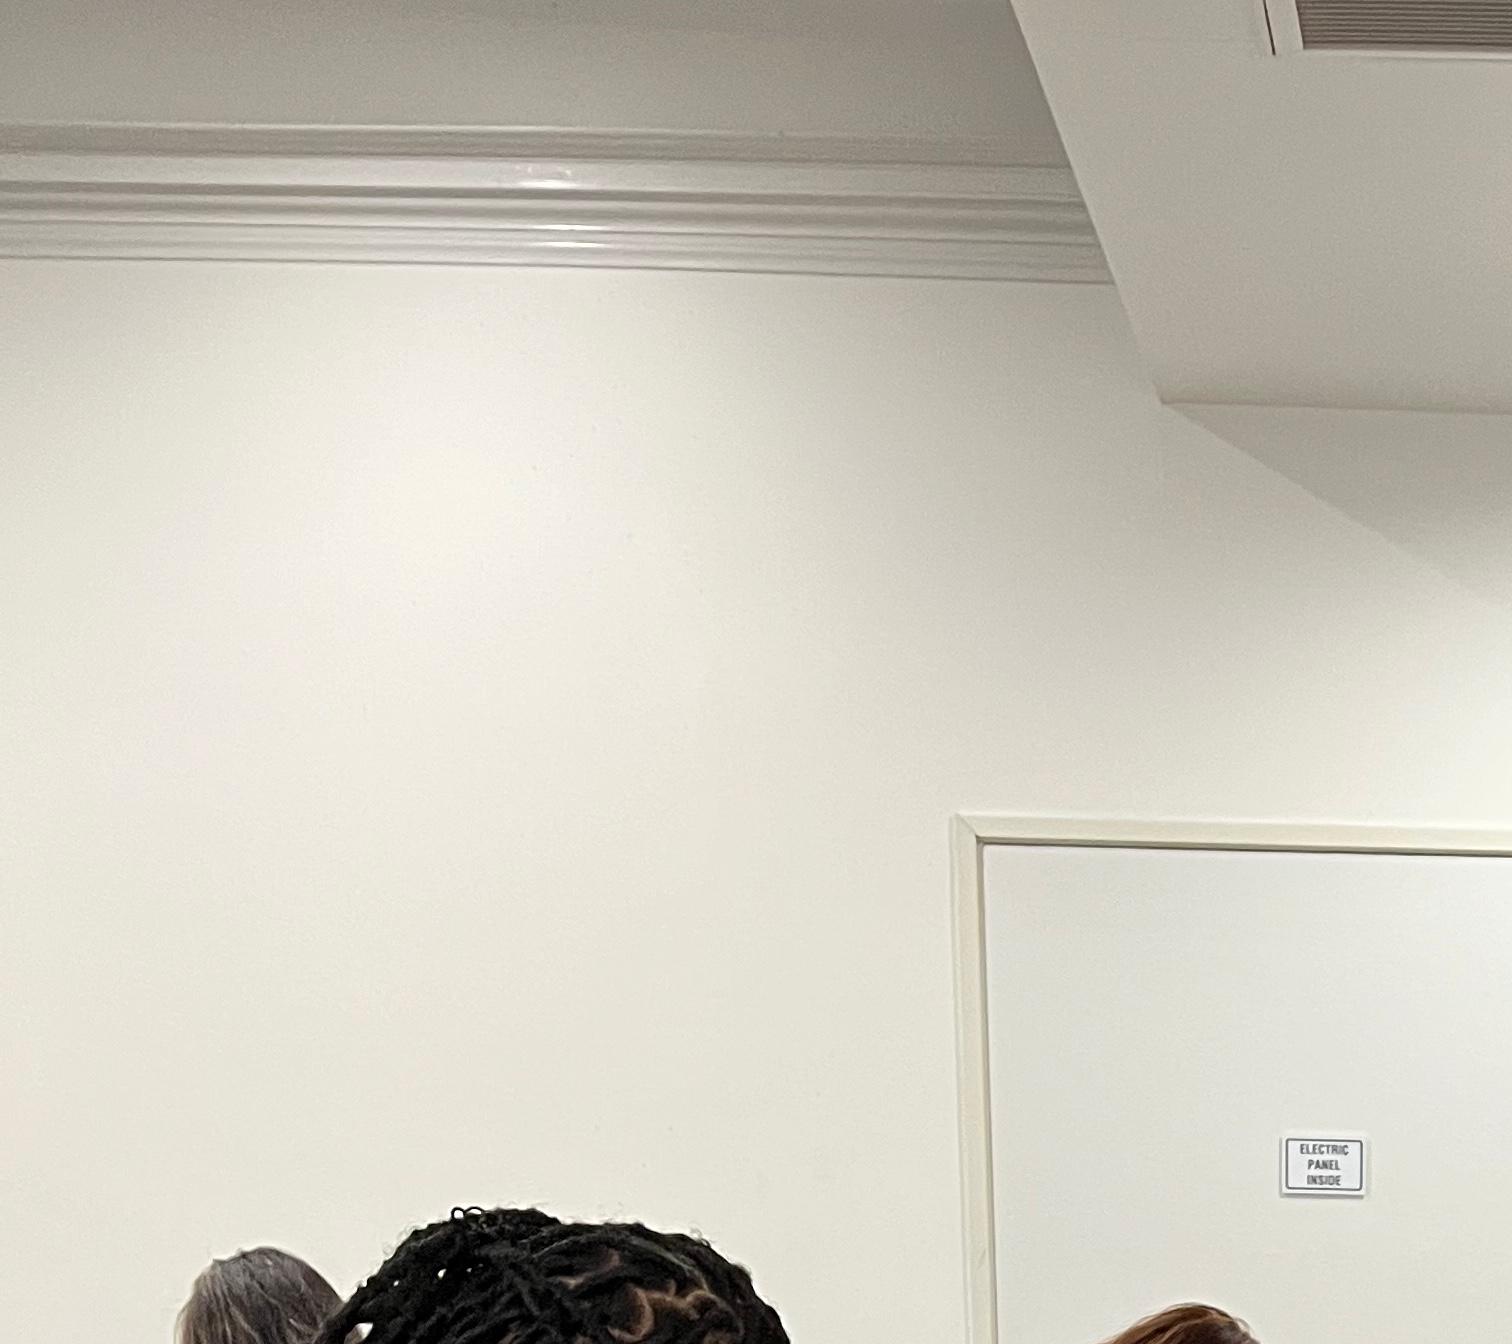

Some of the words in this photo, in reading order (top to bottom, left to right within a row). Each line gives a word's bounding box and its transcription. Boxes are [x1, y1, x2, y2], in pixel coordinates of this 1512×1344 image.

[1300, 1143, 1349, 1155] ELECTRIC
[1308, 1159, 1340, 1170] PANEL
[1306, 1175, 1341, 1186] INSIDE
